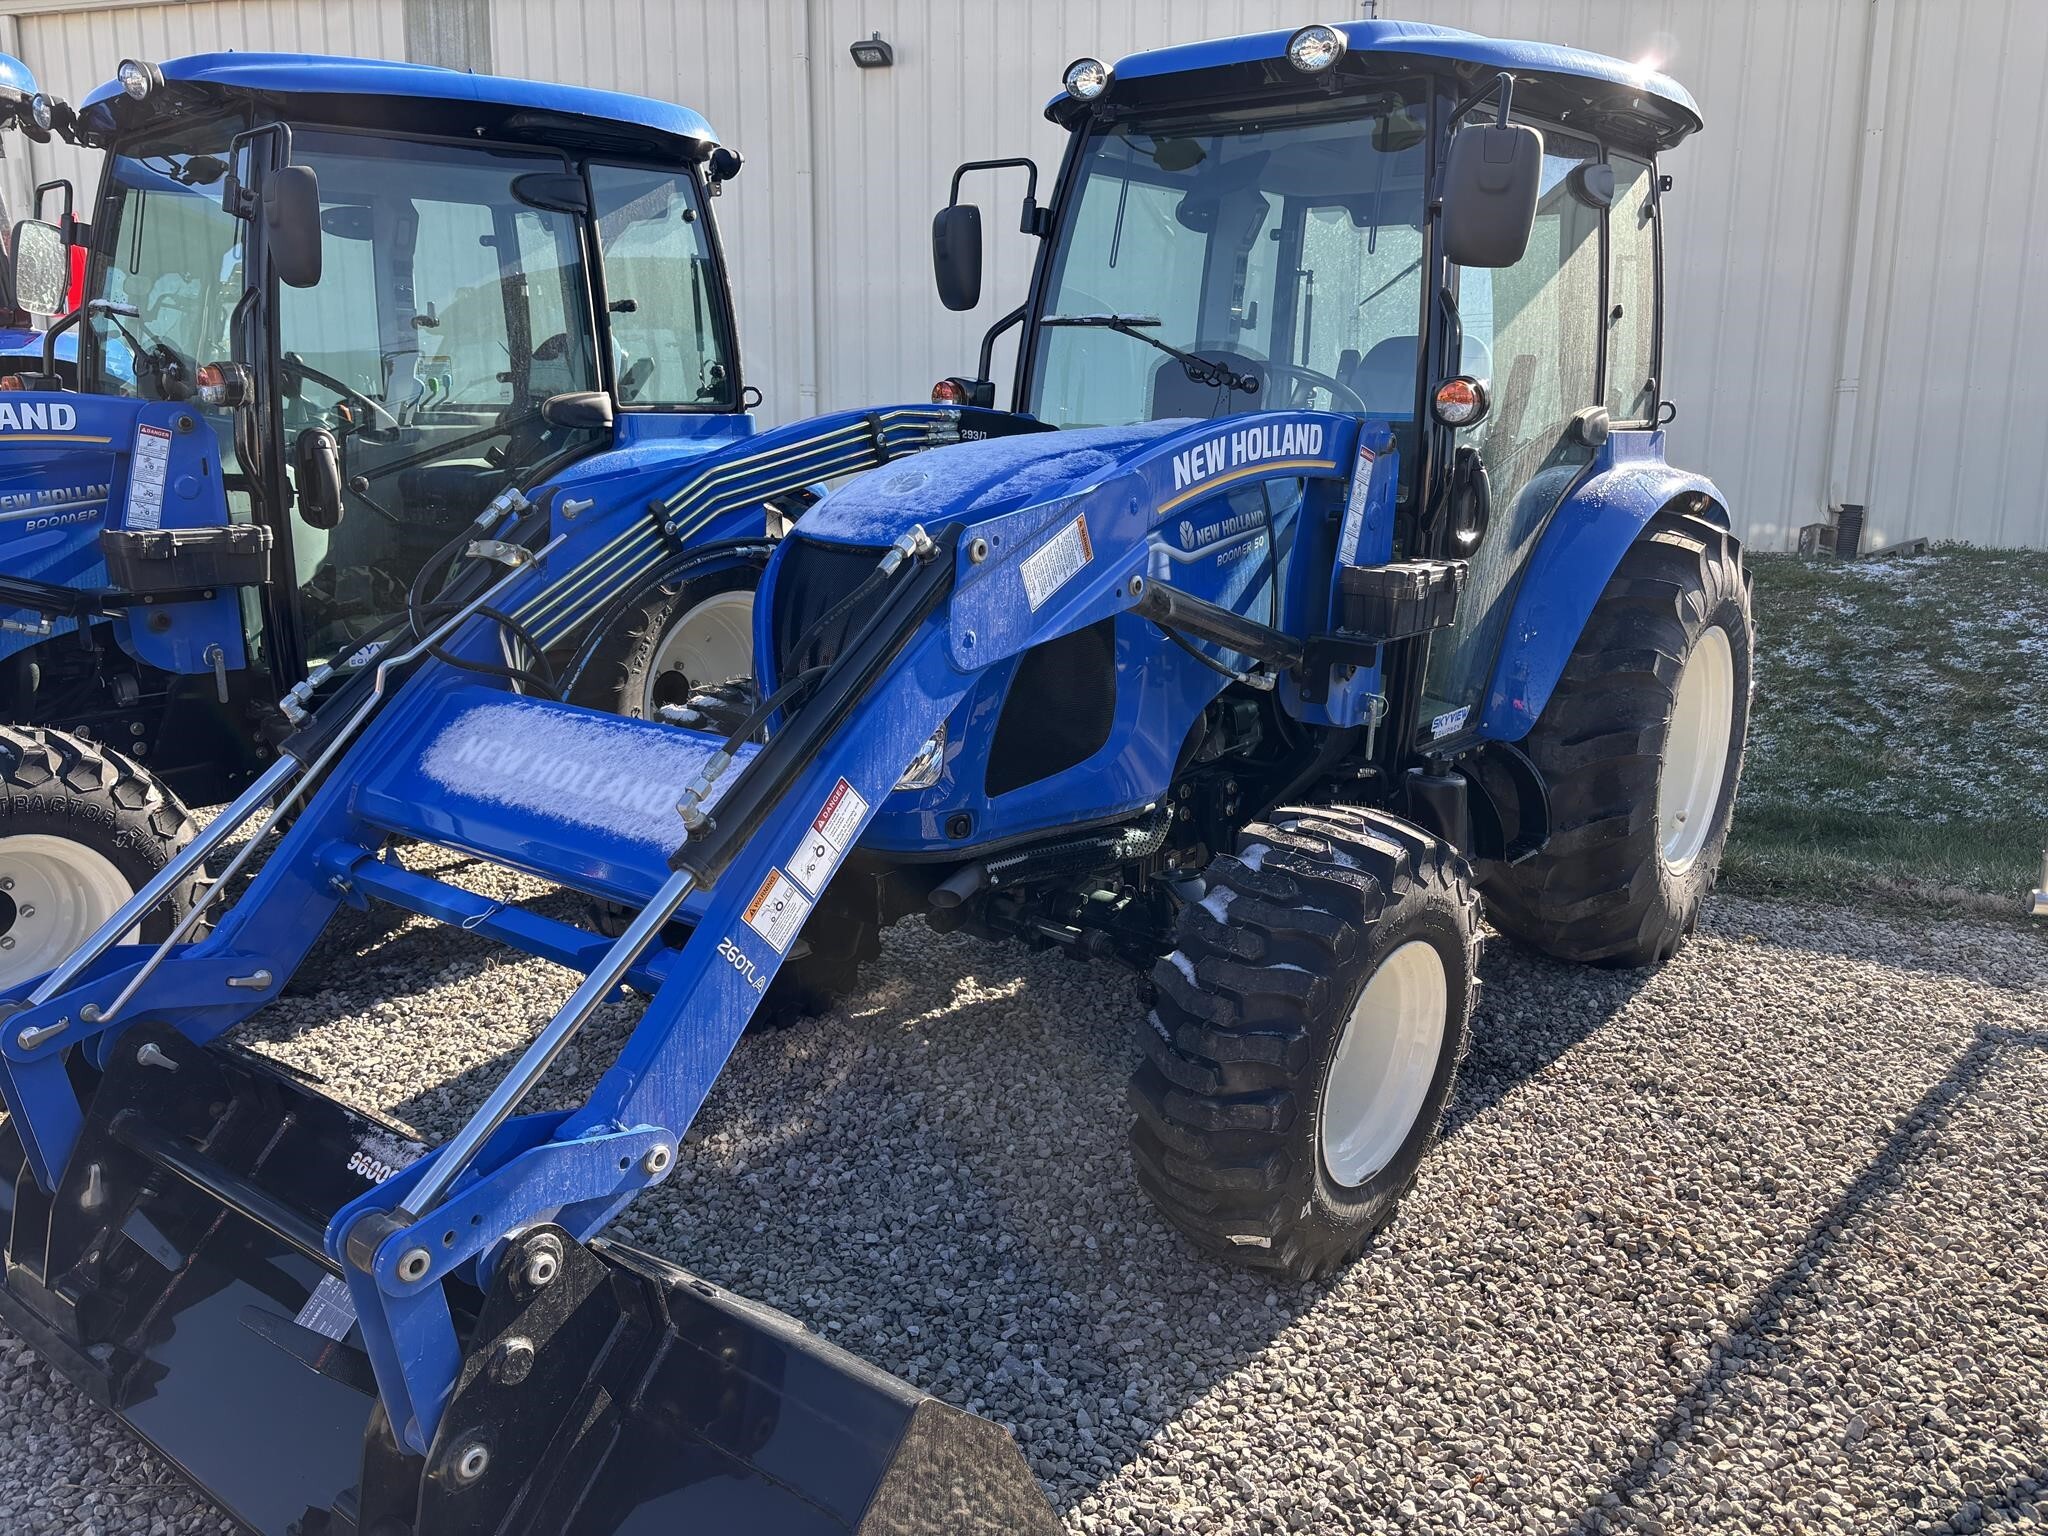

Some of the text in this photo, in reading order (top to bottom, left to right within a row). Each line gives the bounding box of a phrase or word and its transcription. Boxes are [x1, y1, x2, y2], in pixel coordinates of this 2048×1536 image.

[1172, 423, 1323, 490] NEW HOLLAND
[25, 509, 98, 532] BOOMER
[1196, 510, 1265, 545] NEW HOLLAND
[1216, 535, 1264, 567] BOOMER 50
[1432, 708, 1468, 730] SKYVIEW
[822, 784, 846, 819] DANGER
[753, 875, 776, 908] WARNING
[716, 936, 767, 994] 260TLA
